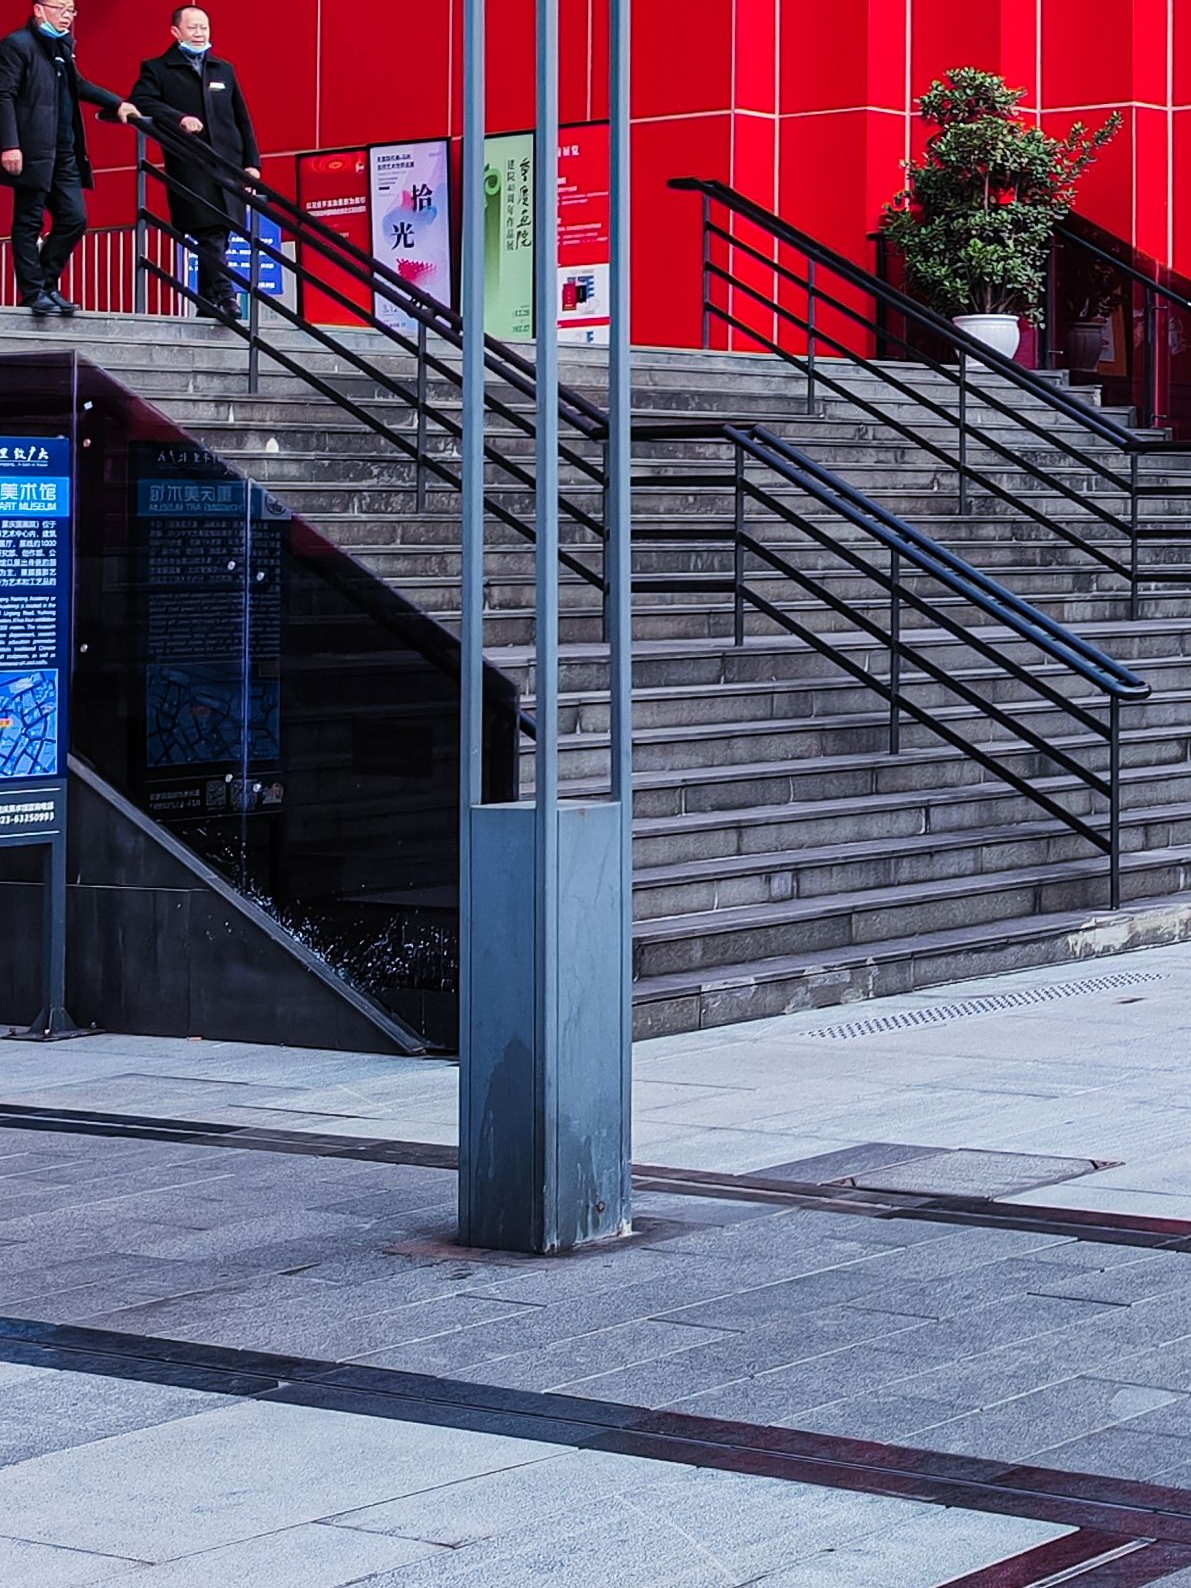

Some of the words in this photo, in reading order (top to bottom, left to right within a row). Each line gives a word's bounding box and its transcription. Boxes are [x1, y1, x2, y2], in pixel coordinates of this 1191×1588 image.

[0, 482, 57, 501] 美术馆
[18, 501, 57, 511] MUSEUM
